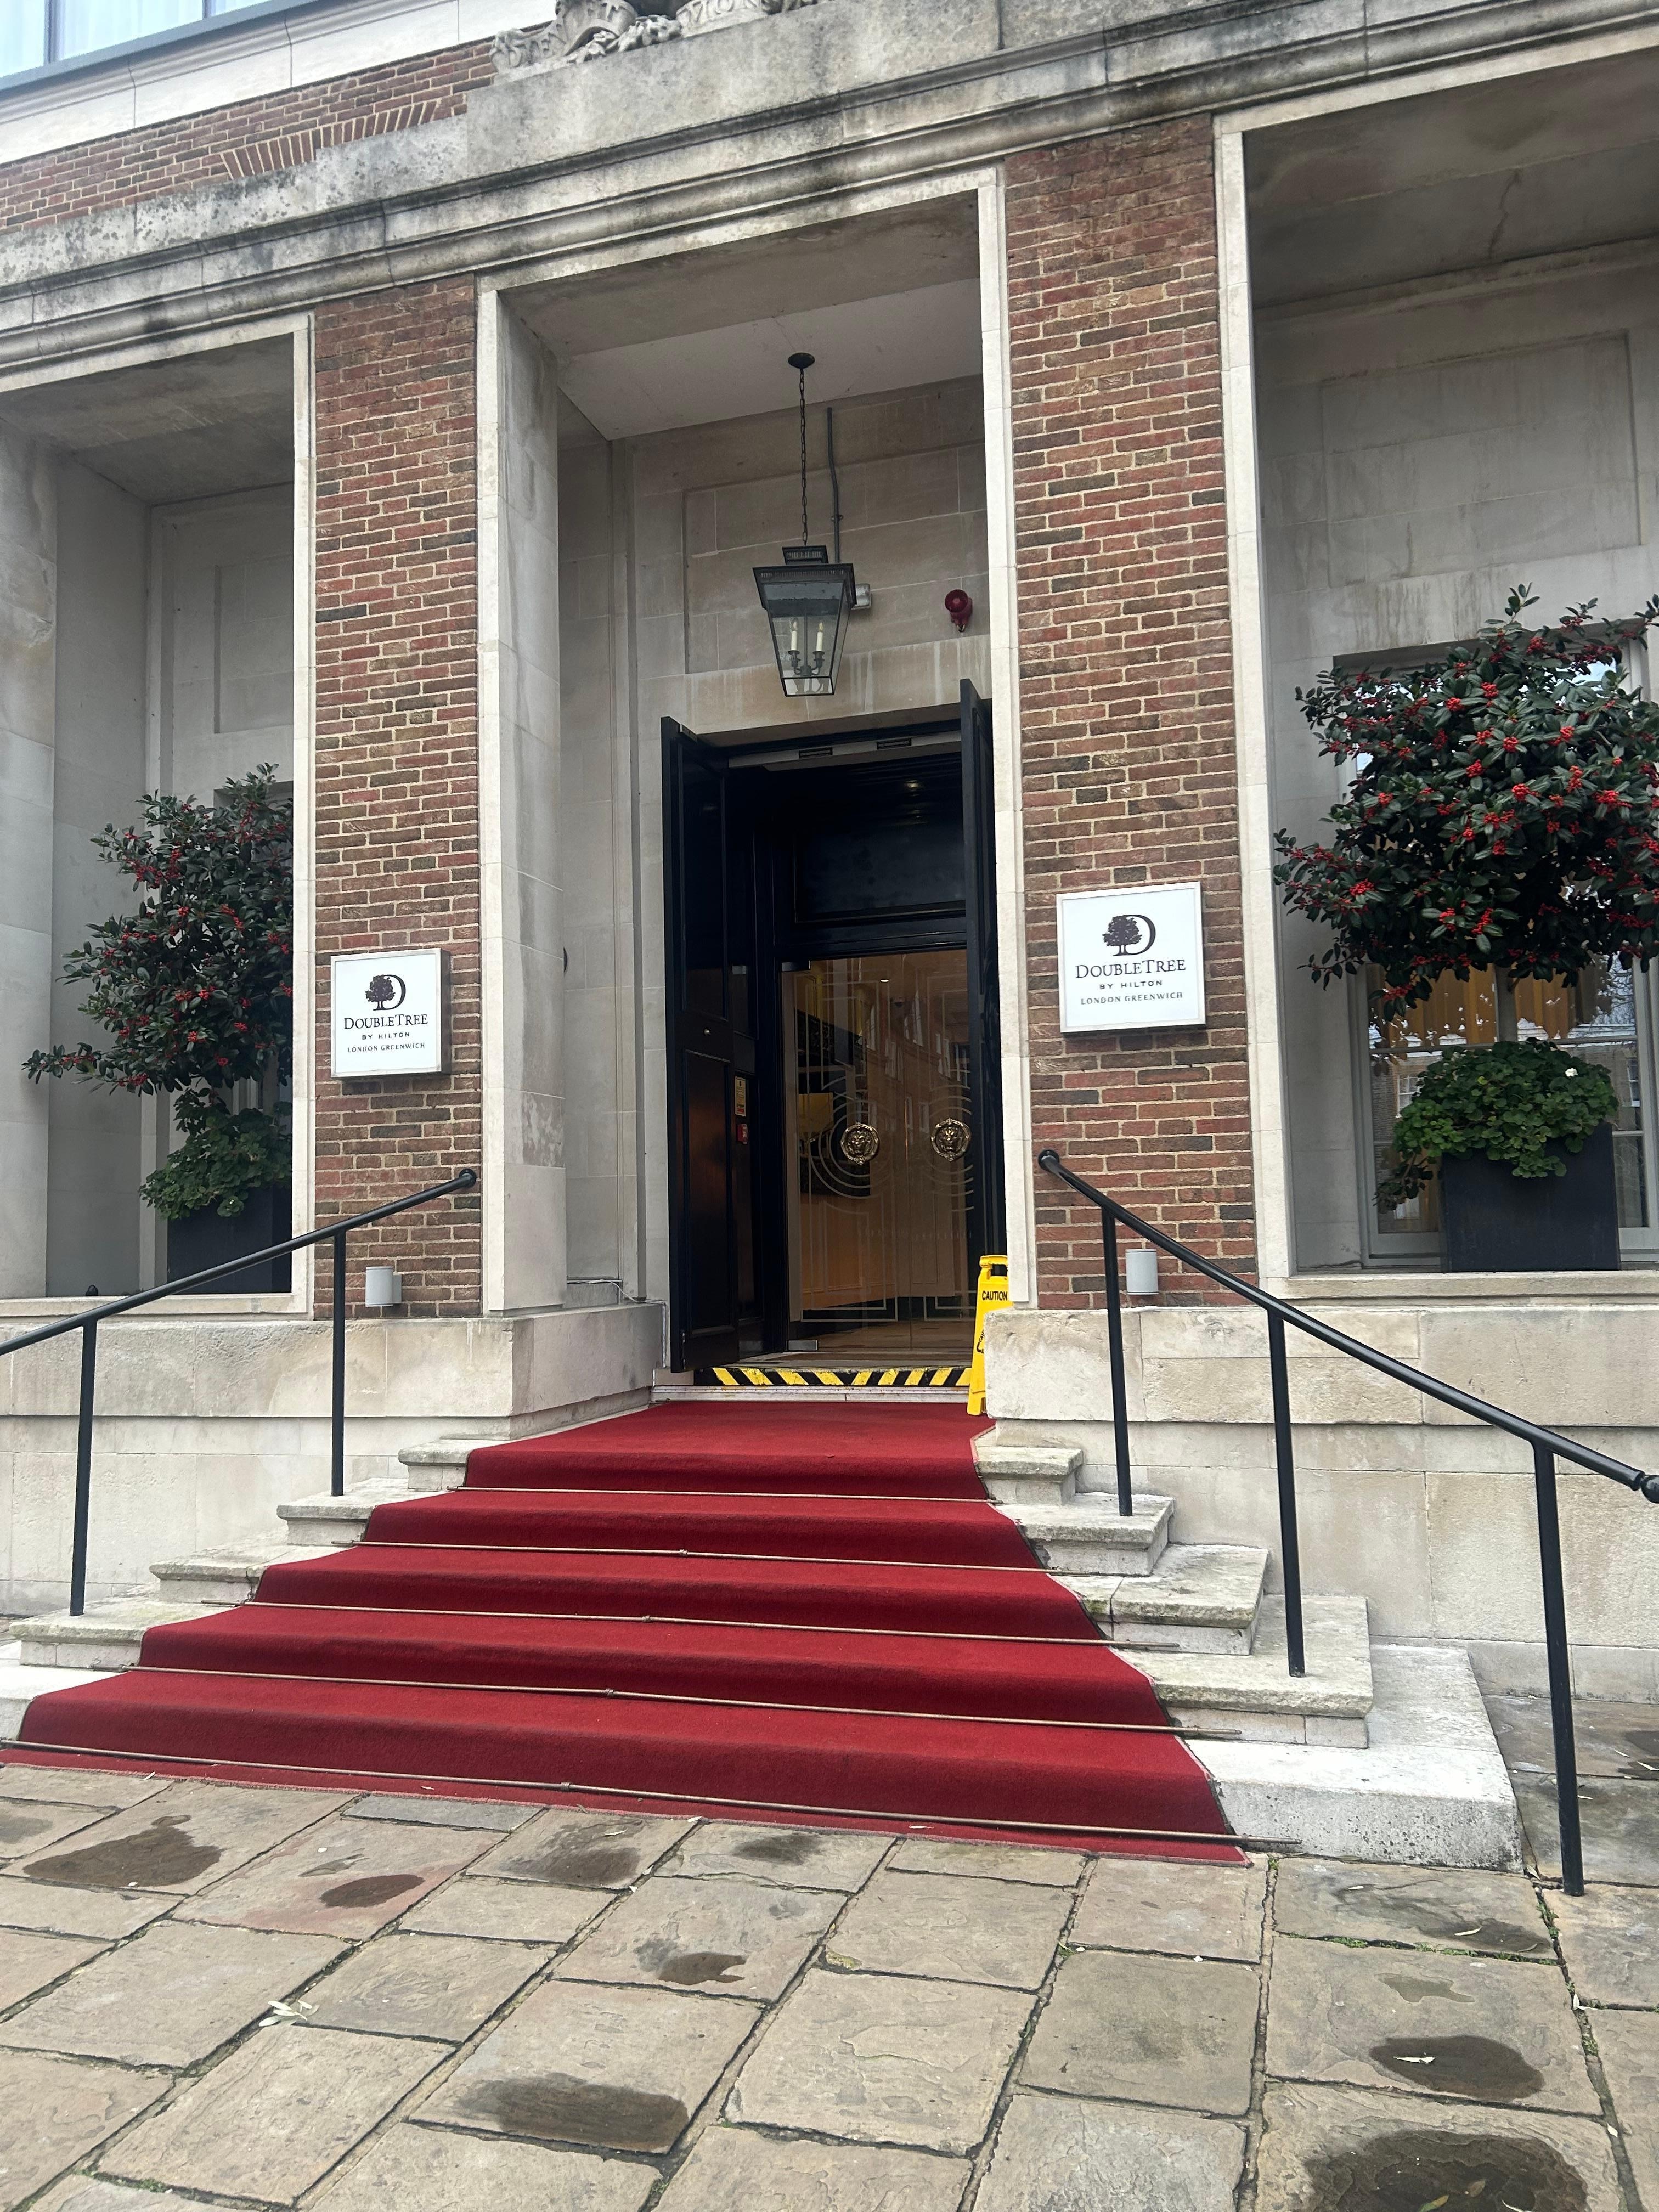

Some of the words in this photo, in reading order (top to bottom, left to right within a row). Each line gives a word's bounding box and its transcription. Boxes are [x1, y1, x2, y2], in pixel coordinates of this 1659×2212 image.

[1081, 996, 1121, 1005] LONDON
[1125, 992, 1183, 1002] GREENWICH
[982, 1291, 1007, 1301] CAUTION
